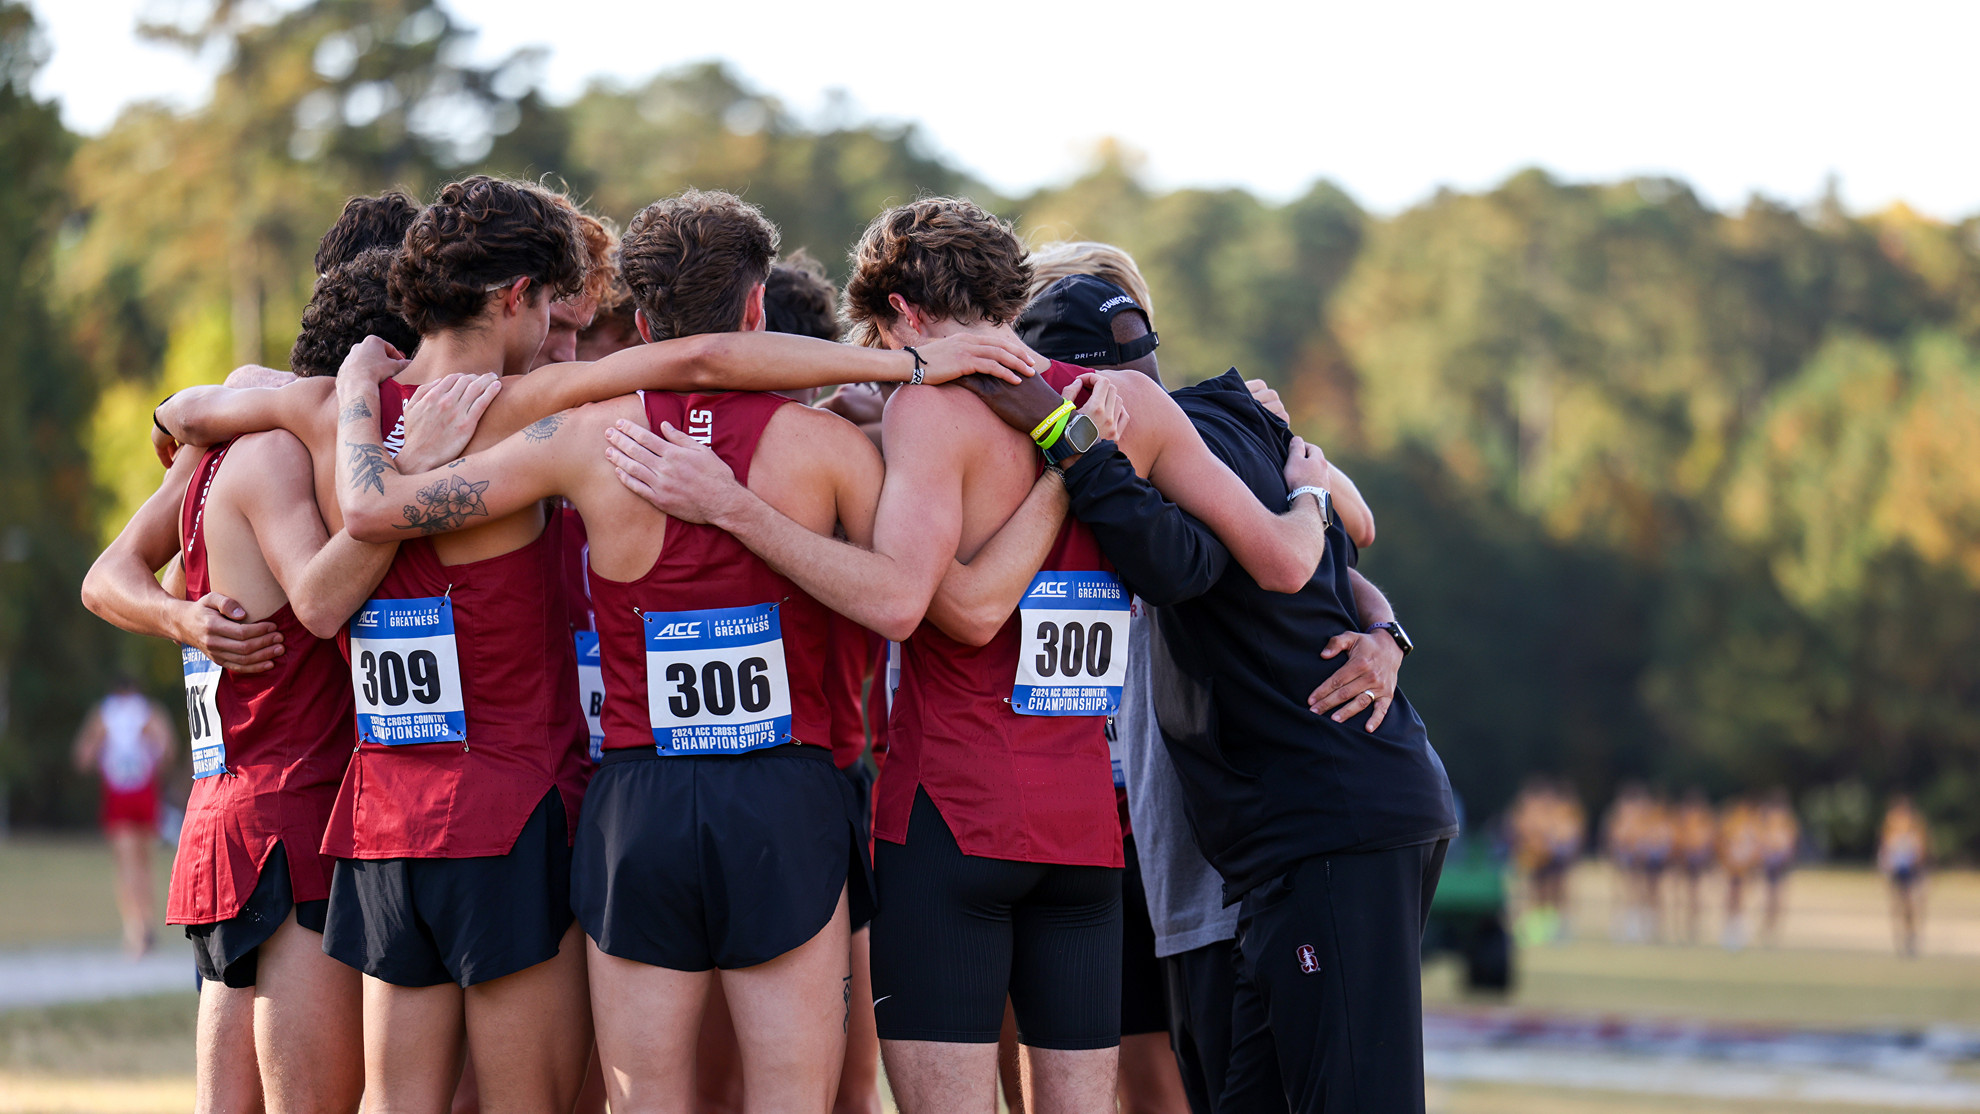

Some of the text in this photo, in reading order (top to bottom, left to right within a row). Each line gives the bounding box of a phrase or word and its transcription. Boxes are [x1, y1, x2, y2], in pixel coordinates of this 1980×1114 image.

[1099, 295, 1133, 313] STANFORD
[1074, 350, 1107, 360] DRI-FIT
[1031, 582, 1069, 594] ACC
[1078, 588, 1121, 599] GREATNESS
[358, 611, 380, 624] ACC
[390, 614, 439, 627] GREATNESS
[714, 614, 768, 626] ACCOMPLISH
[656, 622, 702, 637] ACC
[714, 620, 770, 637] GREATNESS
[1035, 621, 1113, 677] 300
[360, 649, 441, 706] 309
[665, 656, 771, 718] 306
[1031, 688, 1107, 697] 2024 ACC CROSS COUNTRY
[1028, 697, 1108, 711] CHAMPIONSHIPS
[387, 715, 412, 727] CROSS
[413, 714, 446, 725] COUNTRY
[672, 720, 774, 737] 2024 ACC CROSS COUNTRY
[672, 730, 776, 750] CHAMPIONSHIPS
